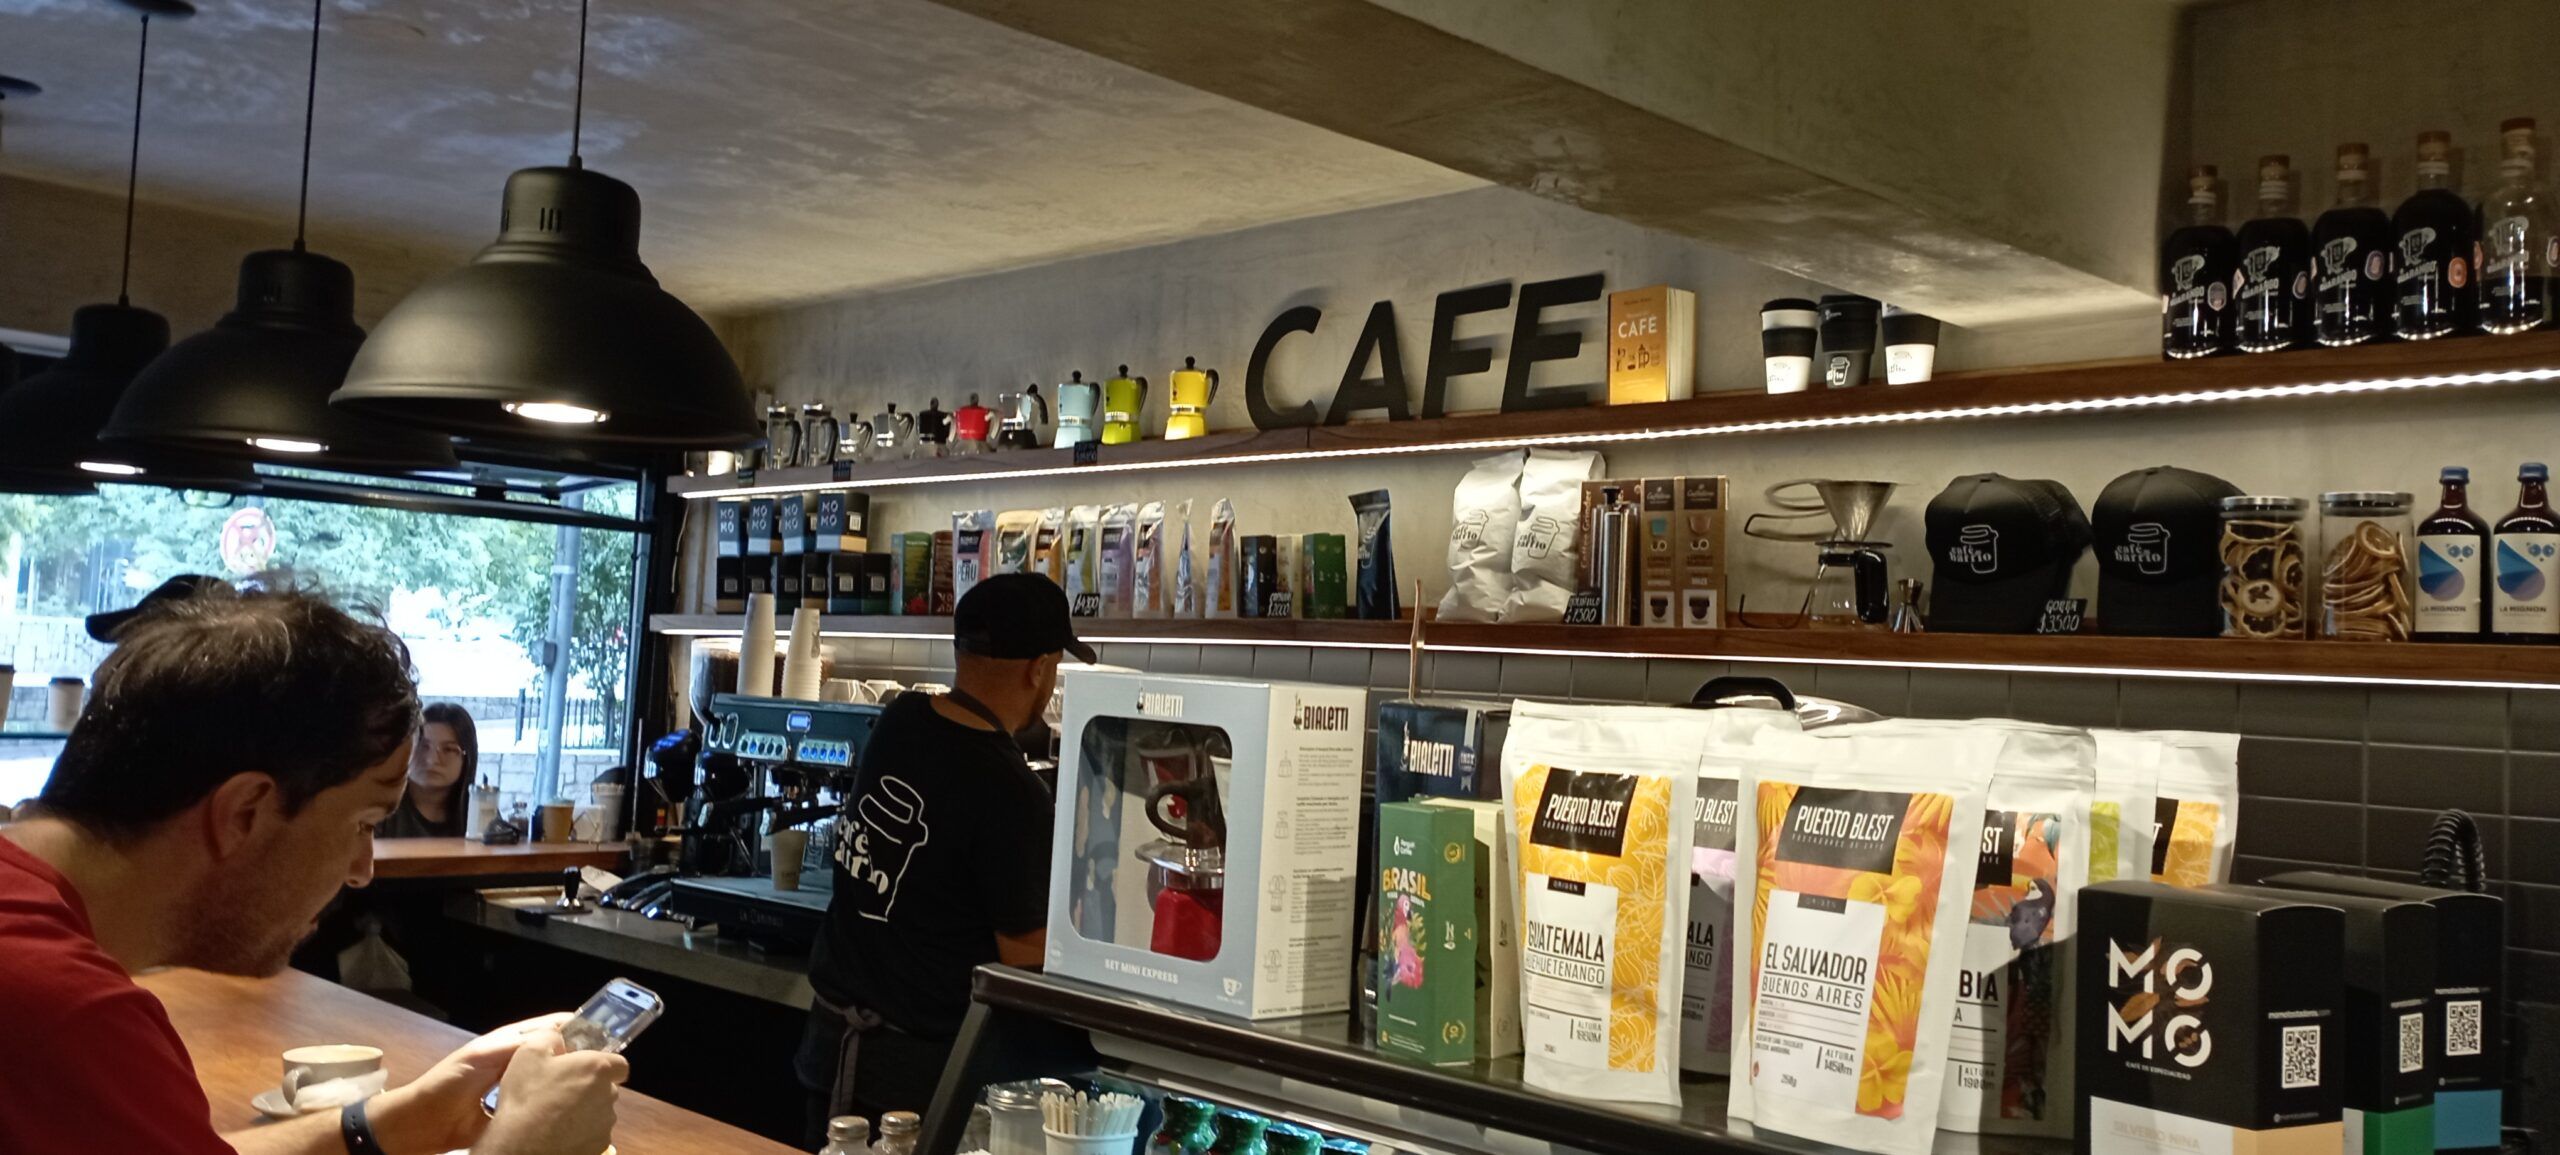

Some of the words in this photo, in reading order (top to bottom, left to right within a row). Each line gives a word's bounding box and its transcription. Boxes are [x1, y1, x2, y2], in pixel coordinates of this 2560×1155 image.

[1245, 273, 1605, 431] CAFE
[2114, 549, 2161, 562] barrio
[2037, 613, 2080, 634] $3500
[1545, 793, 1589, 825] PUERTO
[1588, 798, 1623, 828] BLEST
[1703, 798, 1738, 825] BLEST
[1794, 805, 1851, 838] PUERTO
[1849, 812, 1894, 841] BLEST
[1383, 867, 1431, 901] BRASIL
[1528, 920, 1604, 962] GUATEMALA
[1104, 958, 1119, 971] SET
[1121, 963, 1140, 976] MINI
[1142, 966, 1179, 984] EXPRESS
[1765, 942, 1778, 970] EL
[1782, 945, 1868, 986] SALVADOR
[2108, 936, 2213, 1001] MO
[1762, 975, 1809, 998] BUENOS
[1815, 985, 1864, 1010] AIRES
[1959, 969, 1999, 1001] BIA
[2107, 1001, 2212, 1068] MO
[1825, 1048, 1854, 1062] ALTURA
